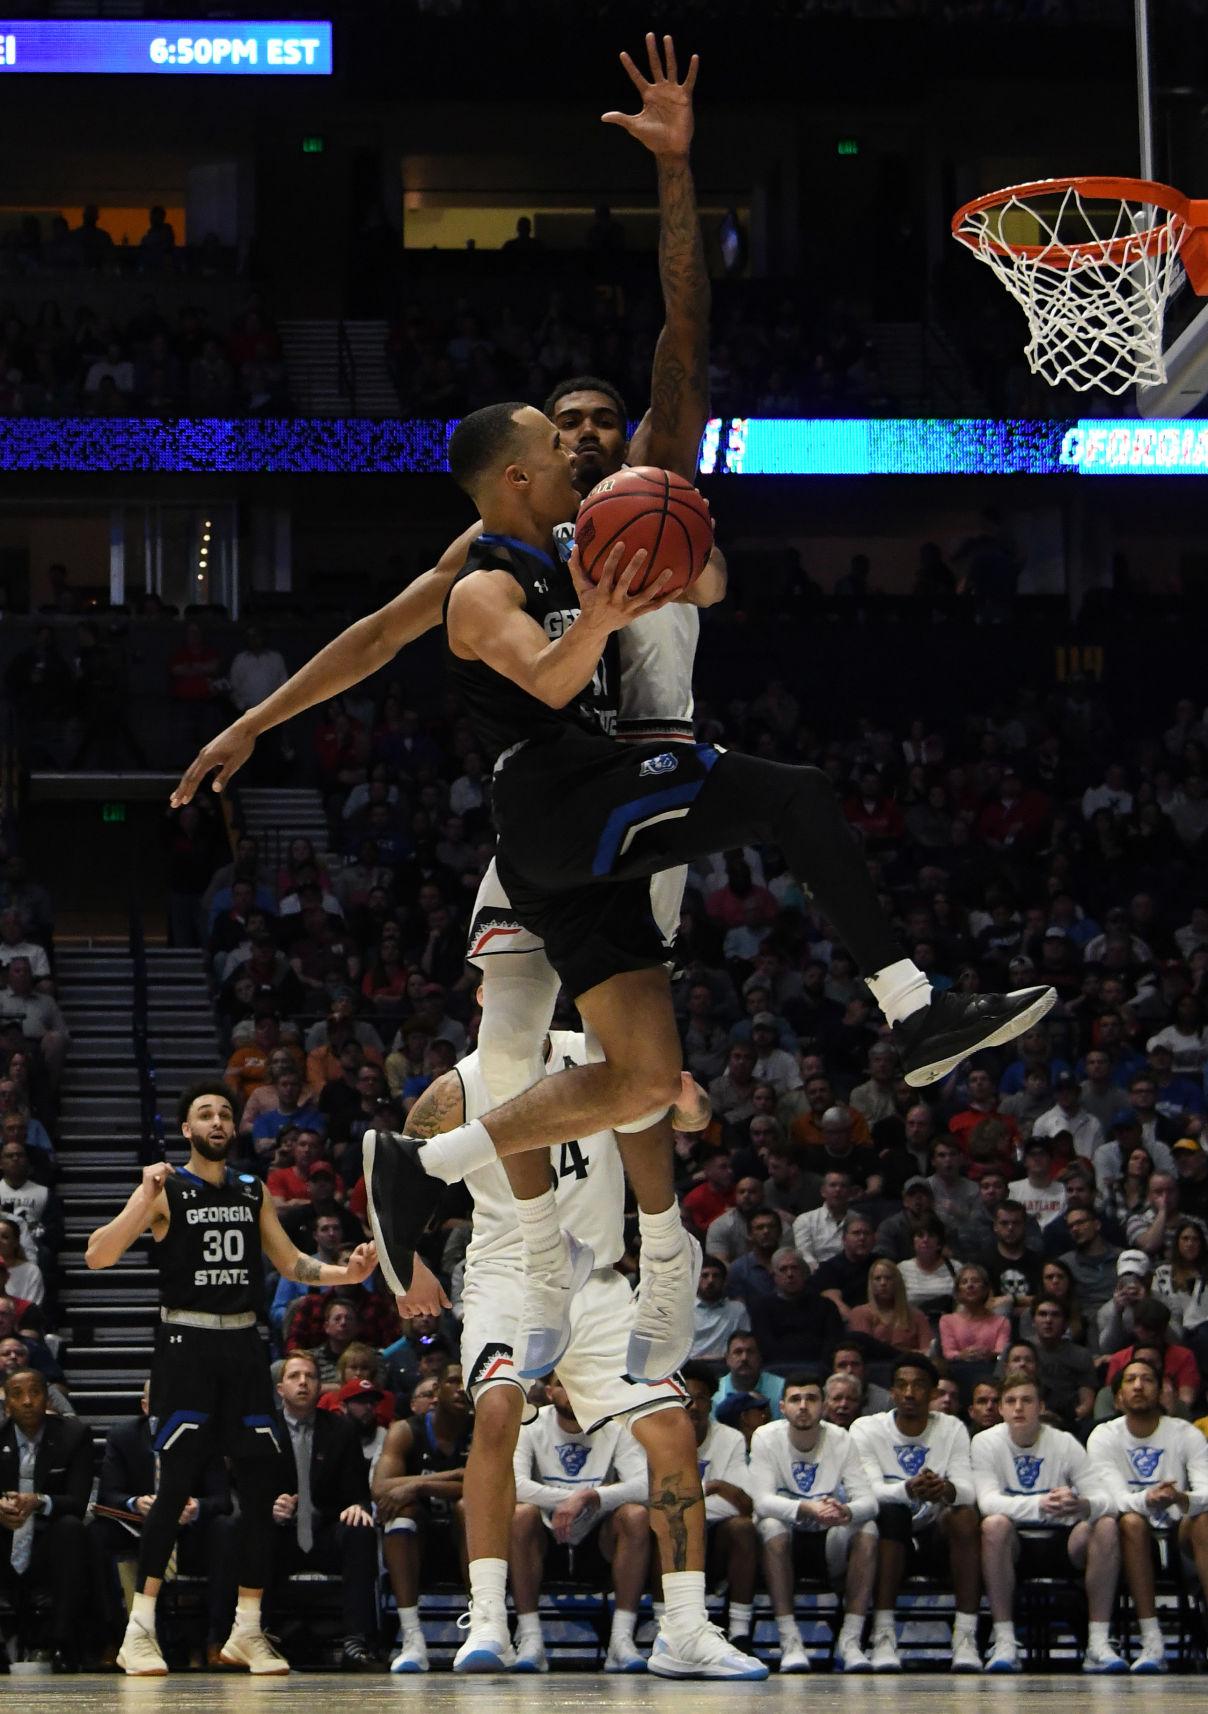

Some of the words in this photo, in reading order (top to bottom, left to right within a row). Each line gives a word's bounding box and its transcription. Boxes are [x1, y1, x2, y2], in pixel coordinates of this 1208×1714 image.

[149, 38, 258, 64] 6:50PM
[266, 38, 319, 65] EST
[186, 1206, 254, 1225] GEORGIA
[203, 1229, 245, 1262] 30
[194, 1269, 249, 1286] STATE
